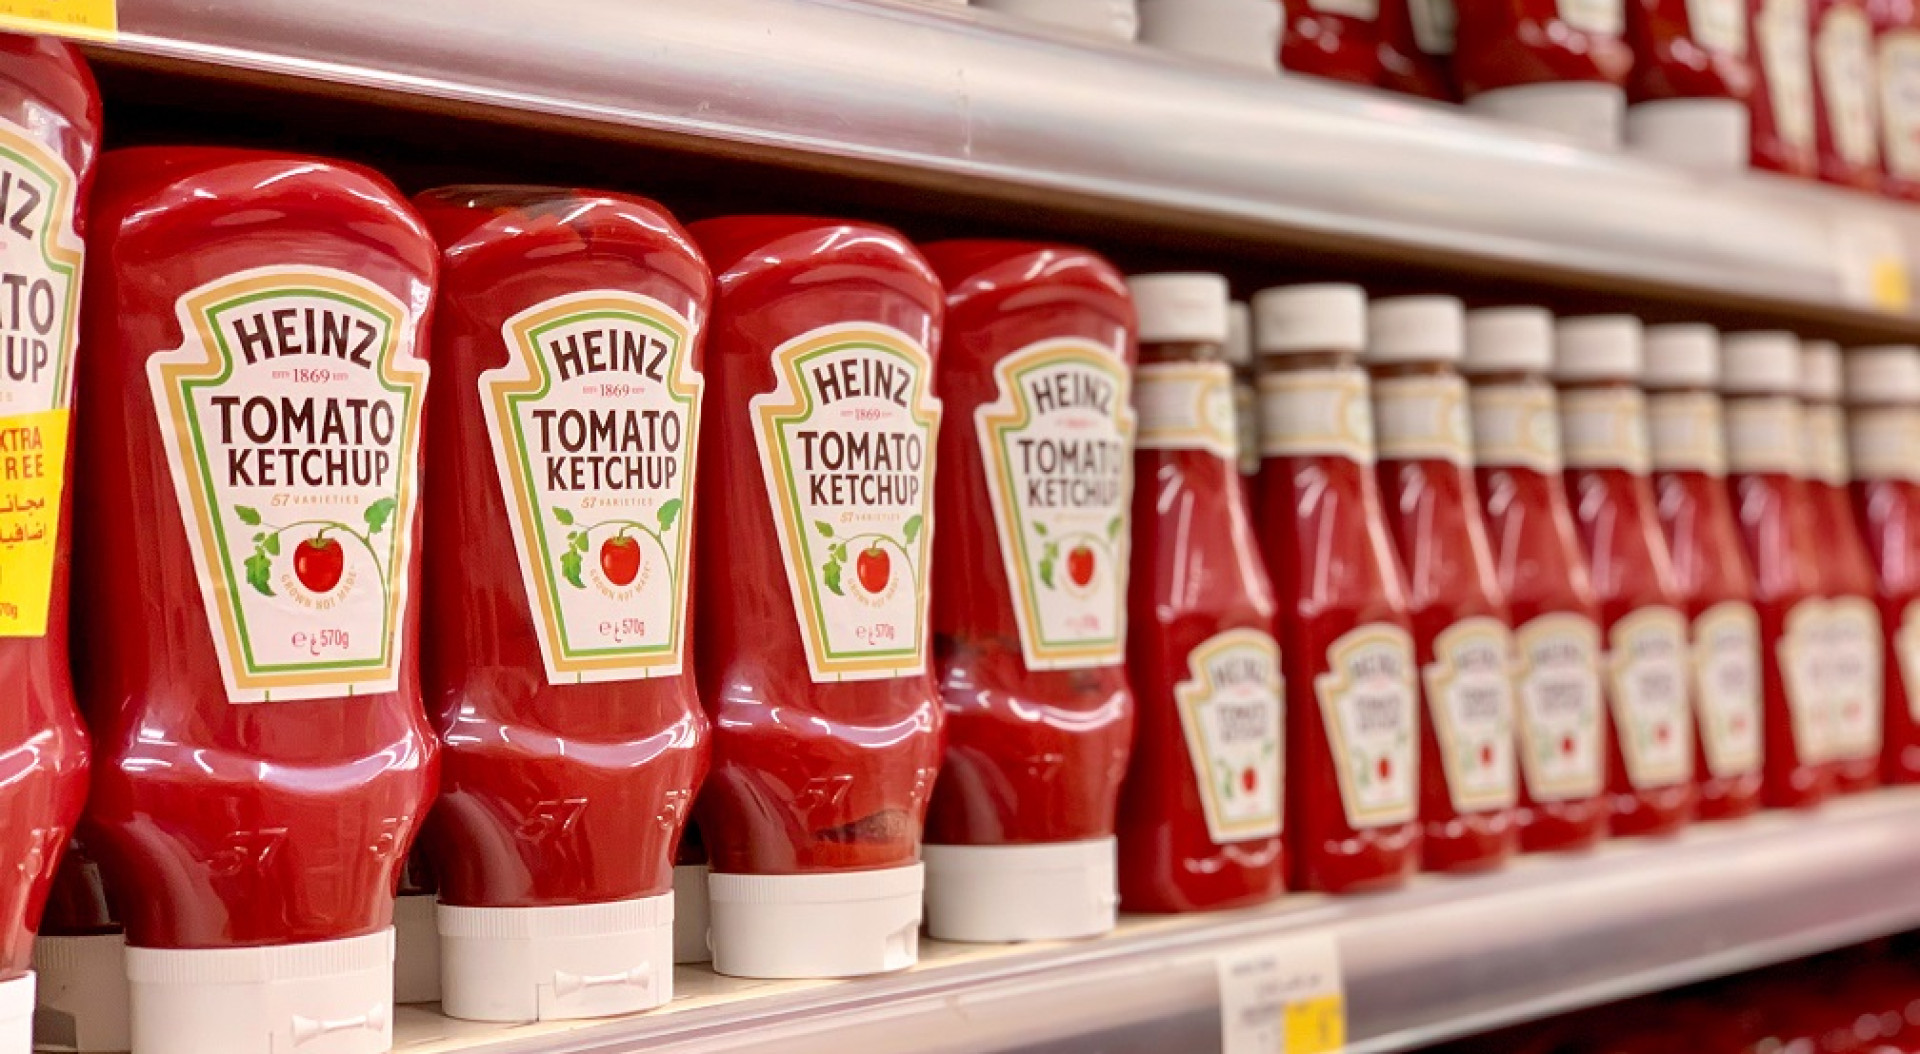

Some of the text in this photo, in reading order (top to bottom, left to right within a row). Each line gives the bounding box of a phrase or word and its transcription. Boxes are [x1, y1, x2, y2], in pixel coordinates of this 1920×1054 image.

[232, 308, 378, 370] HEINZ
[550, 329, 667, 383] HEINZ
[293, 369, 330, 383] 1869
[600, 384, 630, 397] 1869
[813, 358, 911, 408] HEINZ
[1032, 372, 1112, 416] HEINZ
[211, 396, 395, 446] TOMATO
[532, 409, 681, 453] TOMATO
[228, 449, 389, 487] KETCHUP
[796, 430, 921, 472] TOMATO
[547, 456, 677, 491] KETCHUP
[809, 474, 919, 506] KETCHUP
[271, 492, 290, 506] 57
[580, 497, 597, 508] 57
[320, 629, 350, 650] 570g
